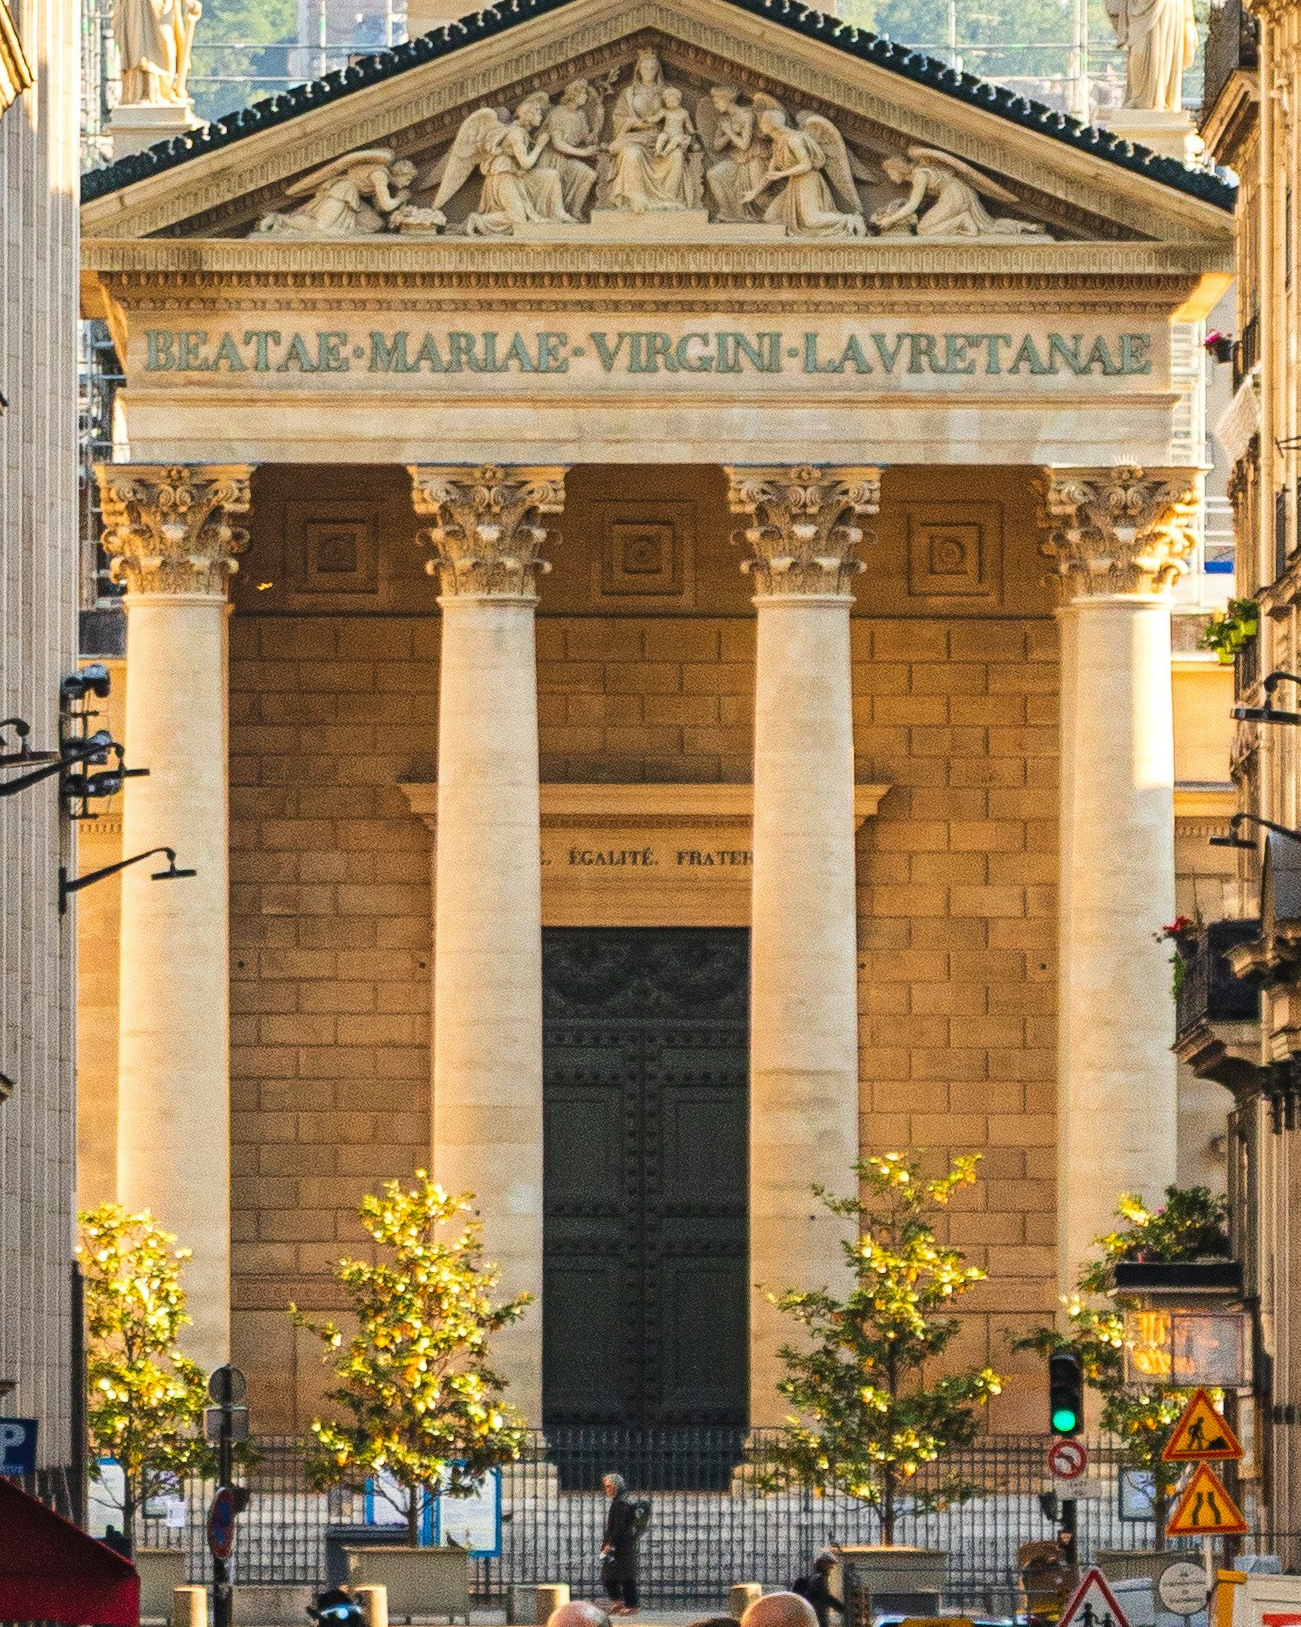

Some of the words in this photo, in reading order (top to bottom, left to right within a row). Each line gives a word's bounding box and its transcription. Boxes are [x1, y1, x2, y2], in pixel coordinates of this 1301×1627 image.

[144, 329, 349, 372] BEATAE
[368, 331, 571, 373] MARIAE
[592, 331, 783, 373] VIRGINI
[804, 332, 1153, 375] LAVRETANAE
